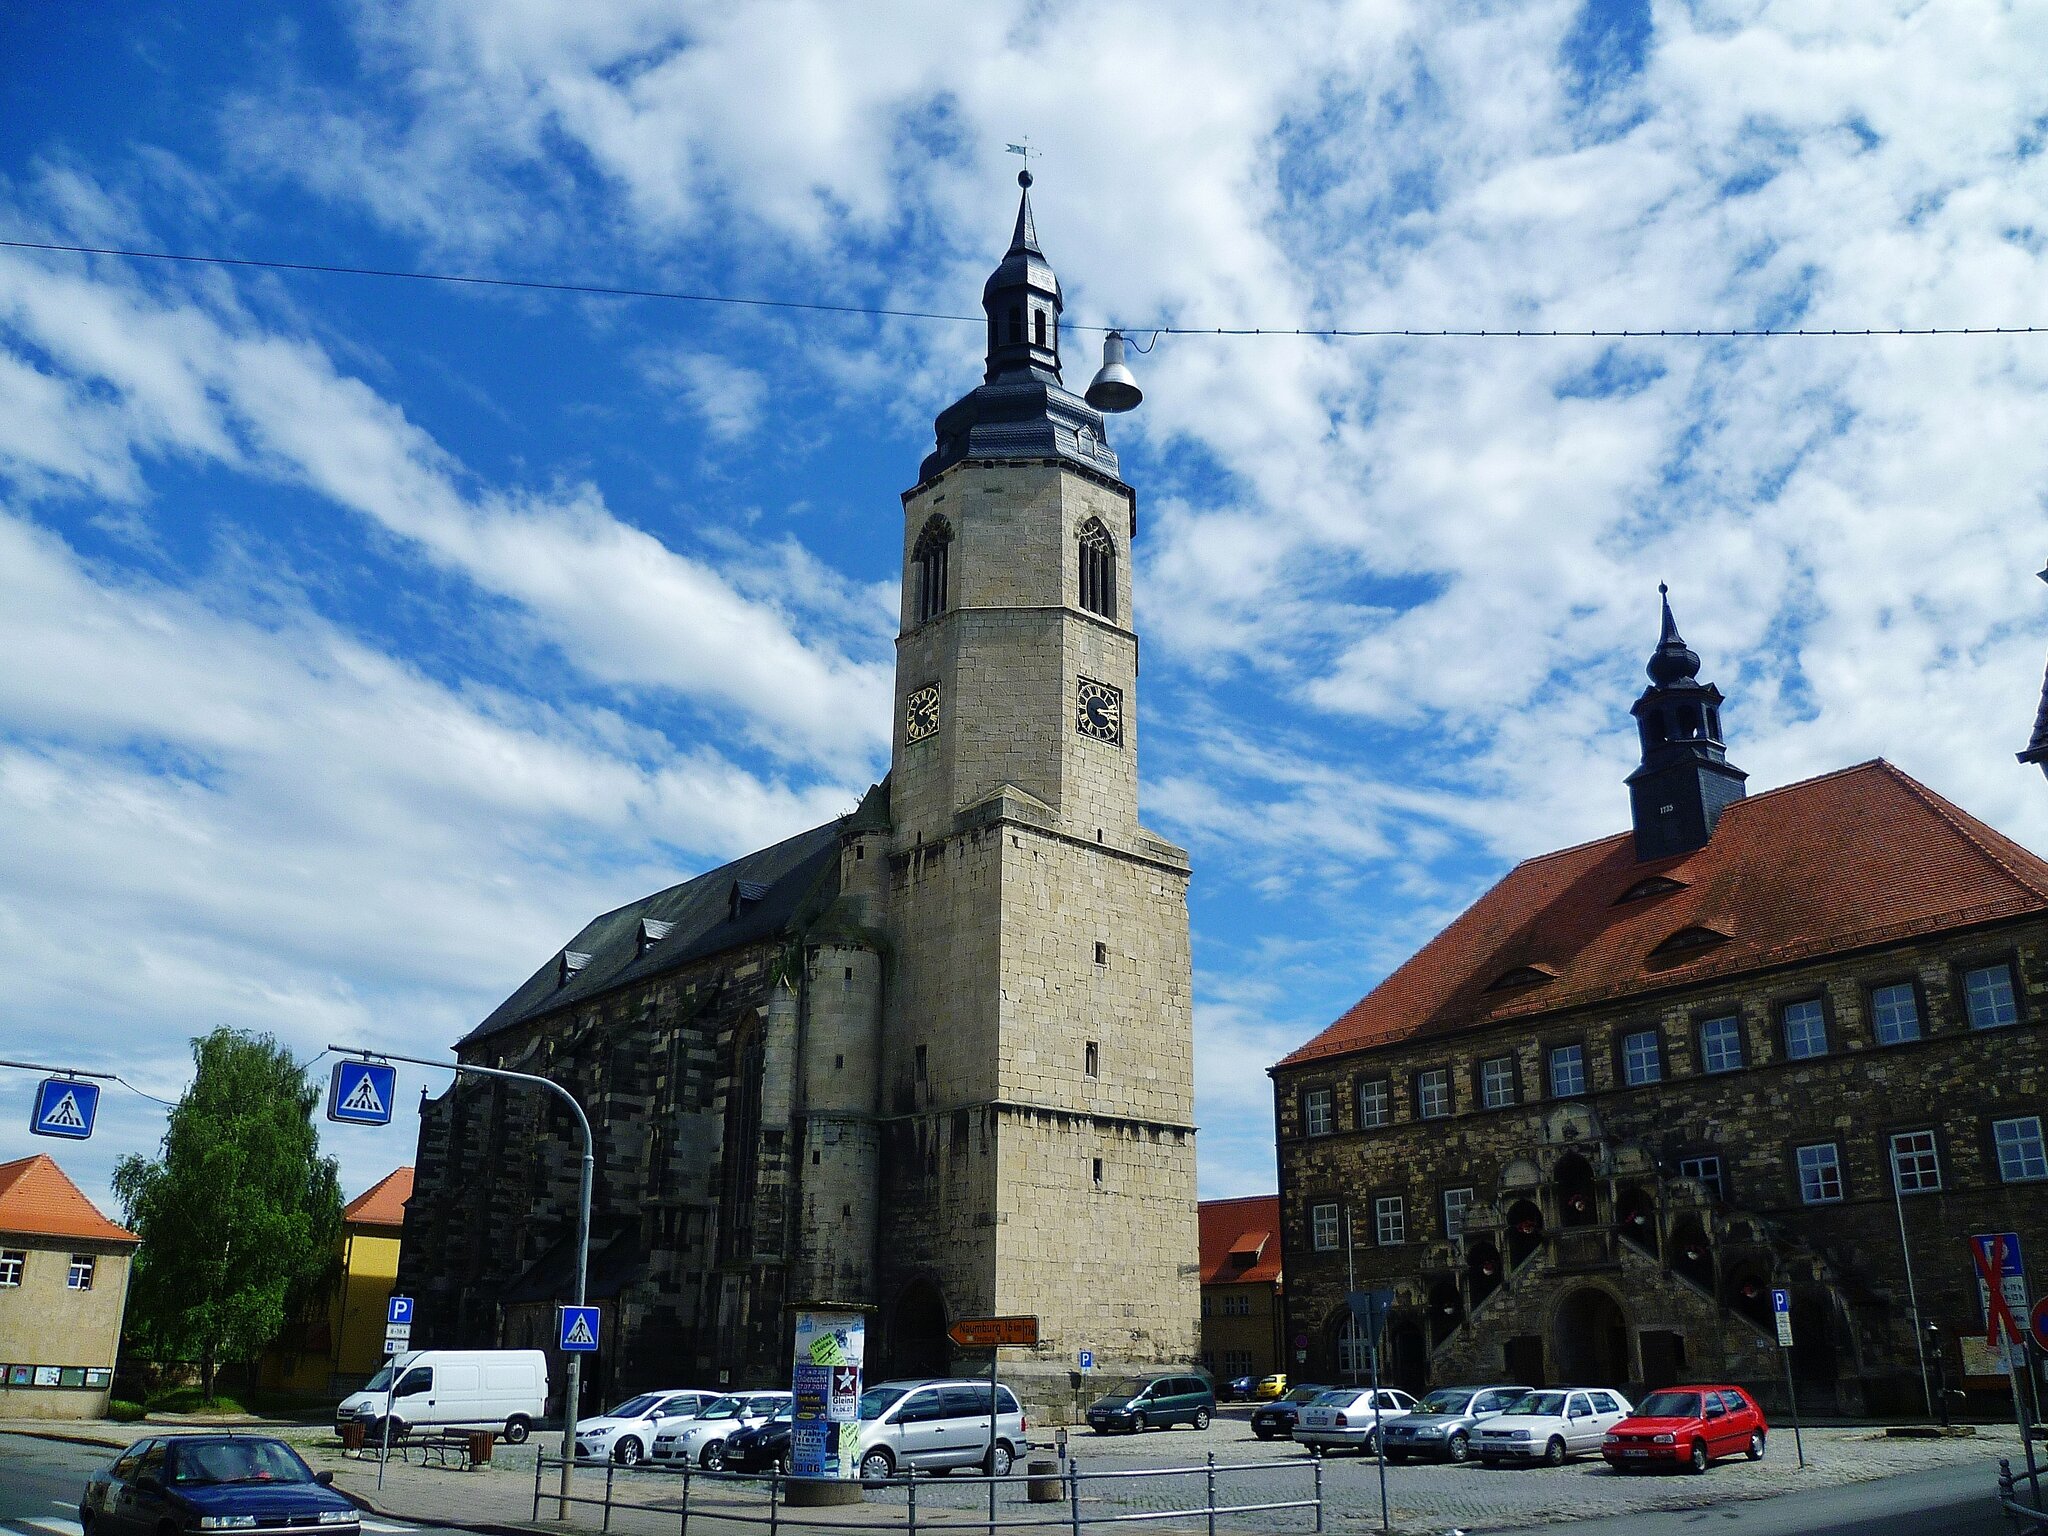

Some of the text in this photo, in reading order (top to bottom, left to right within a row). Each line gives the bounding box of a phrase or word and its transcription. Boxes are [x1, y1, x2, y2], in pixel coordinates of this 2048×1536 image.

[1776, 1293, 1783, 1310] P
[394, 1301, 407, 1319] P
[959, 1323, 1000, 1335] Naumburg
[1005, 1321, 1013, 1331] 16
[1025, 1325, 1035, 1336] 176
[1083, 1353, 1089, 1365] P
[832, 1396, 854, 1405] Gleina
